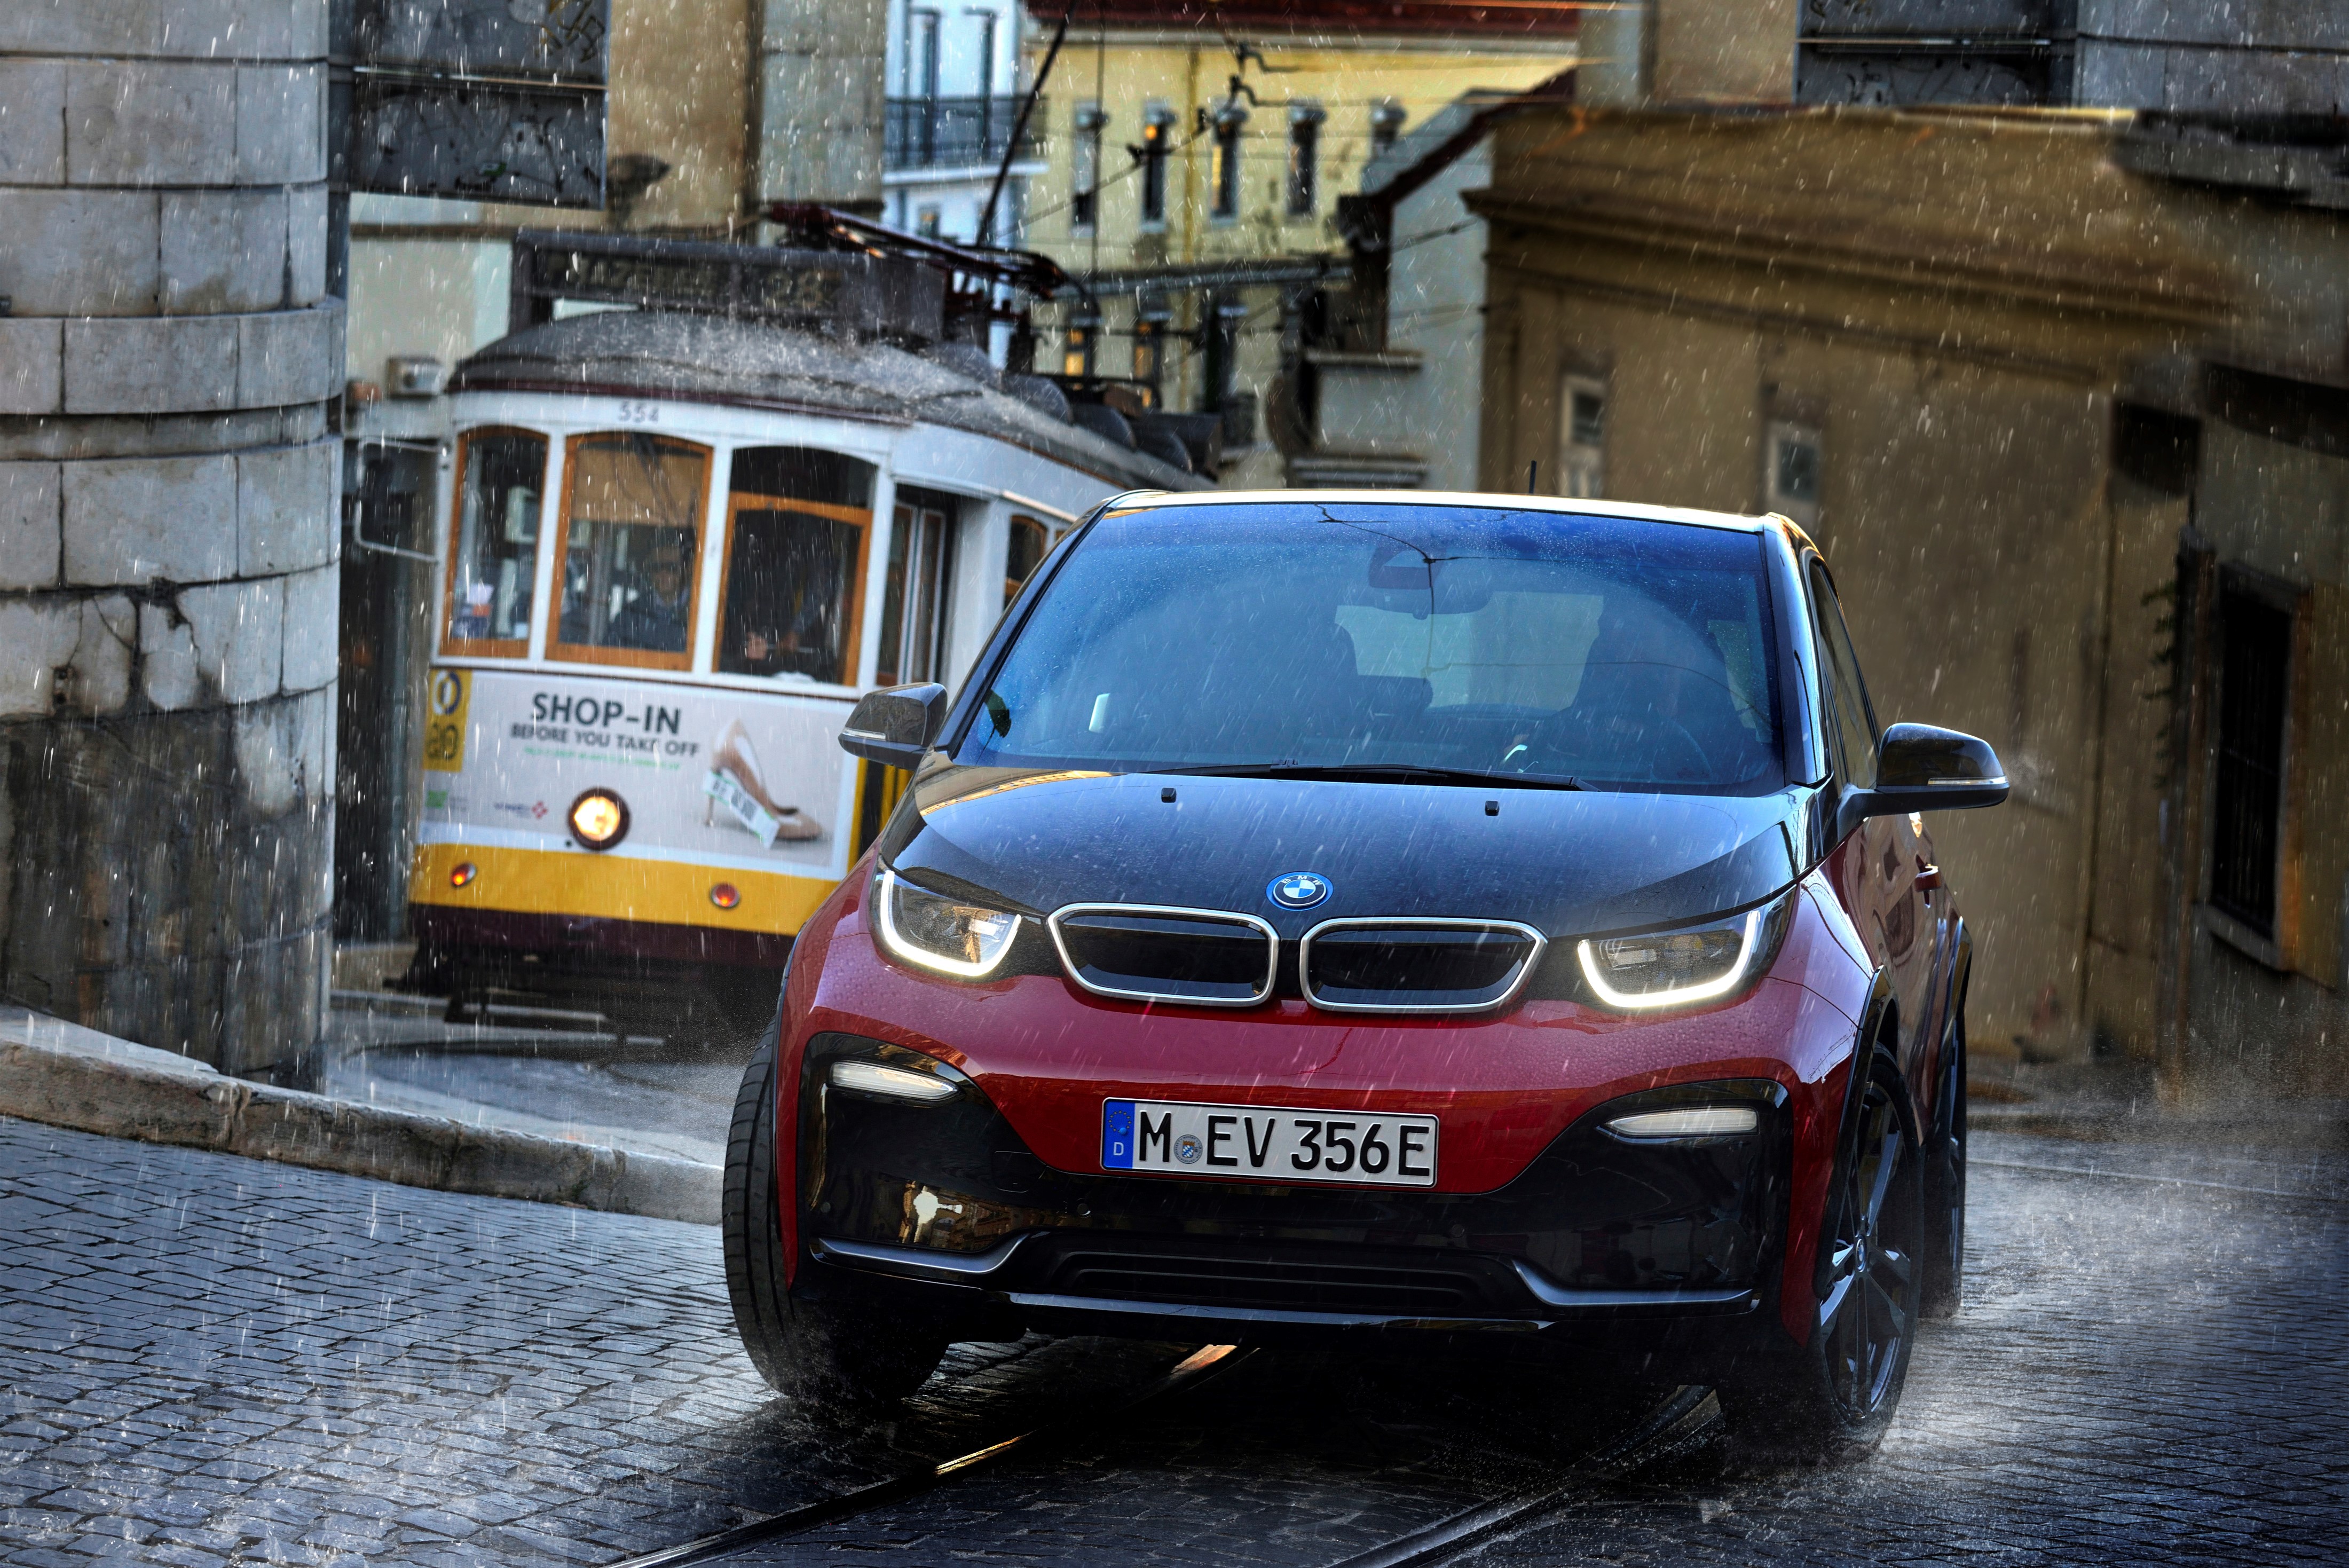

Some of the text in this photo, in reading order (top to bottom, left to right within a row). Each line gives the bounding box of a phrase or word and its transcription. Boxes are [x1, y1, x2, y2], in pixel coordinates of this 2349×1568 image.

[763, 271, 823, 309] 28
[532, 692, 682, 735] SHOP-IN
[510, 722, 700, 757] BEFORE YOU TAKE OFF
[1281, 875, 1323, 885] BMW
[1114, 1142, 1124, 1156] D
[1139, 1112, 1171, 1162] M
[1207, 1115, 1275, 1168] EV
[1291, 1119, 1430, 1177] 356E
